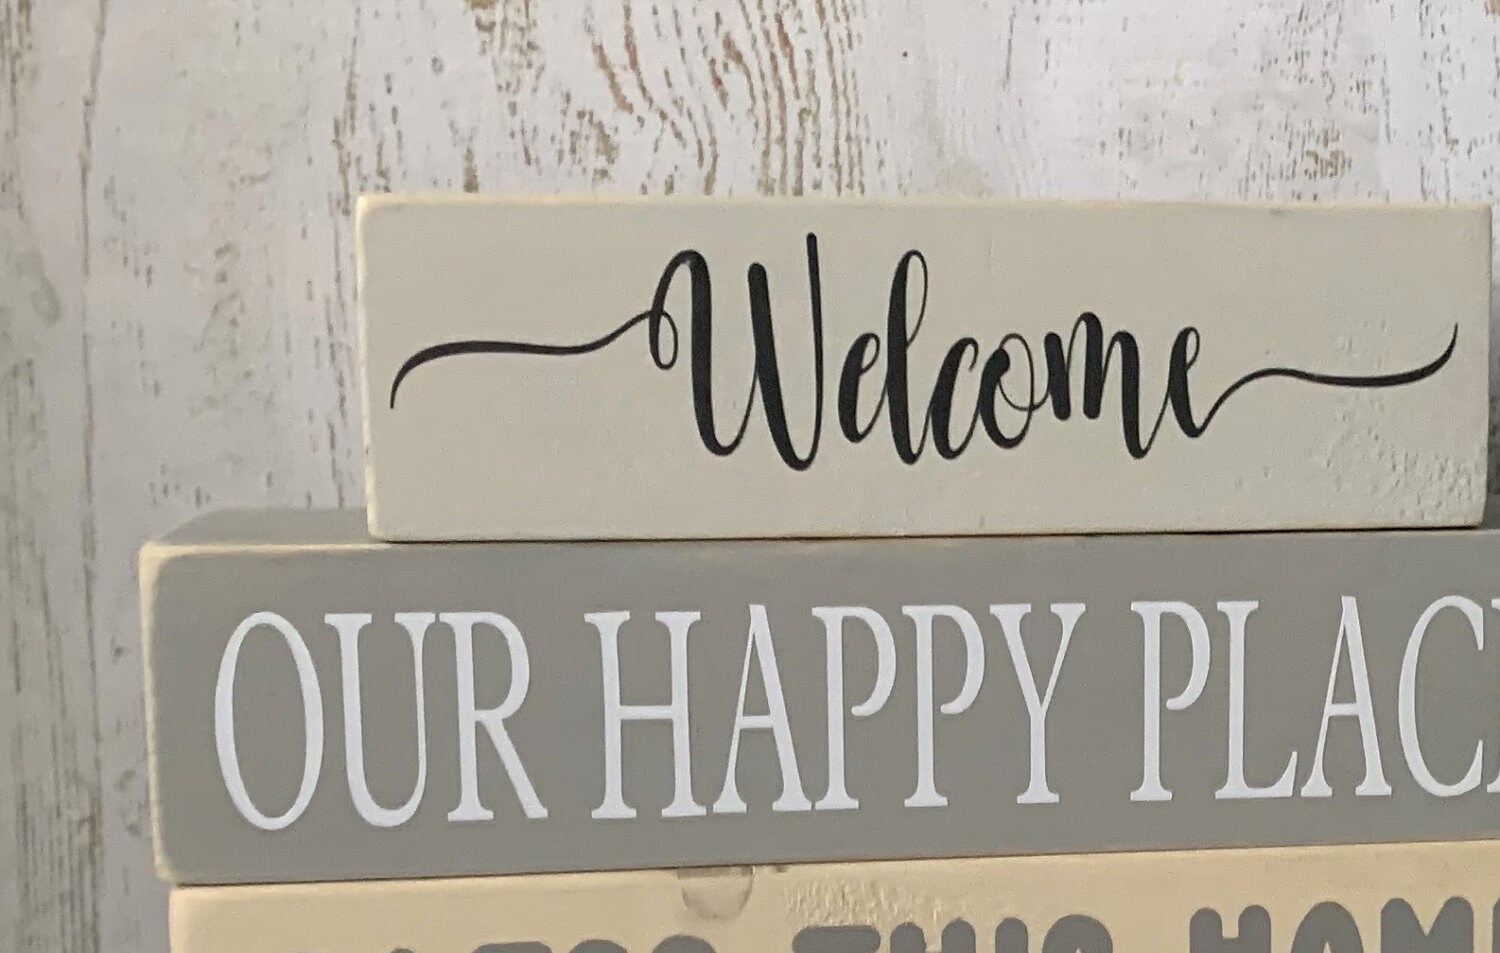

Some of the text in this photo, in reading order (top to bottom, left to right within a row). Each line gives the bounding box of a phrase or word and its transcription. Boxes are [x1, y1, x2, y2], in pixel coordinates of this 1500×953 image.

[390, 232, 1458, 472] Welcome
[214, 611, 548, 831] OUR
[585, 602, 1086, 818] HAPPY
